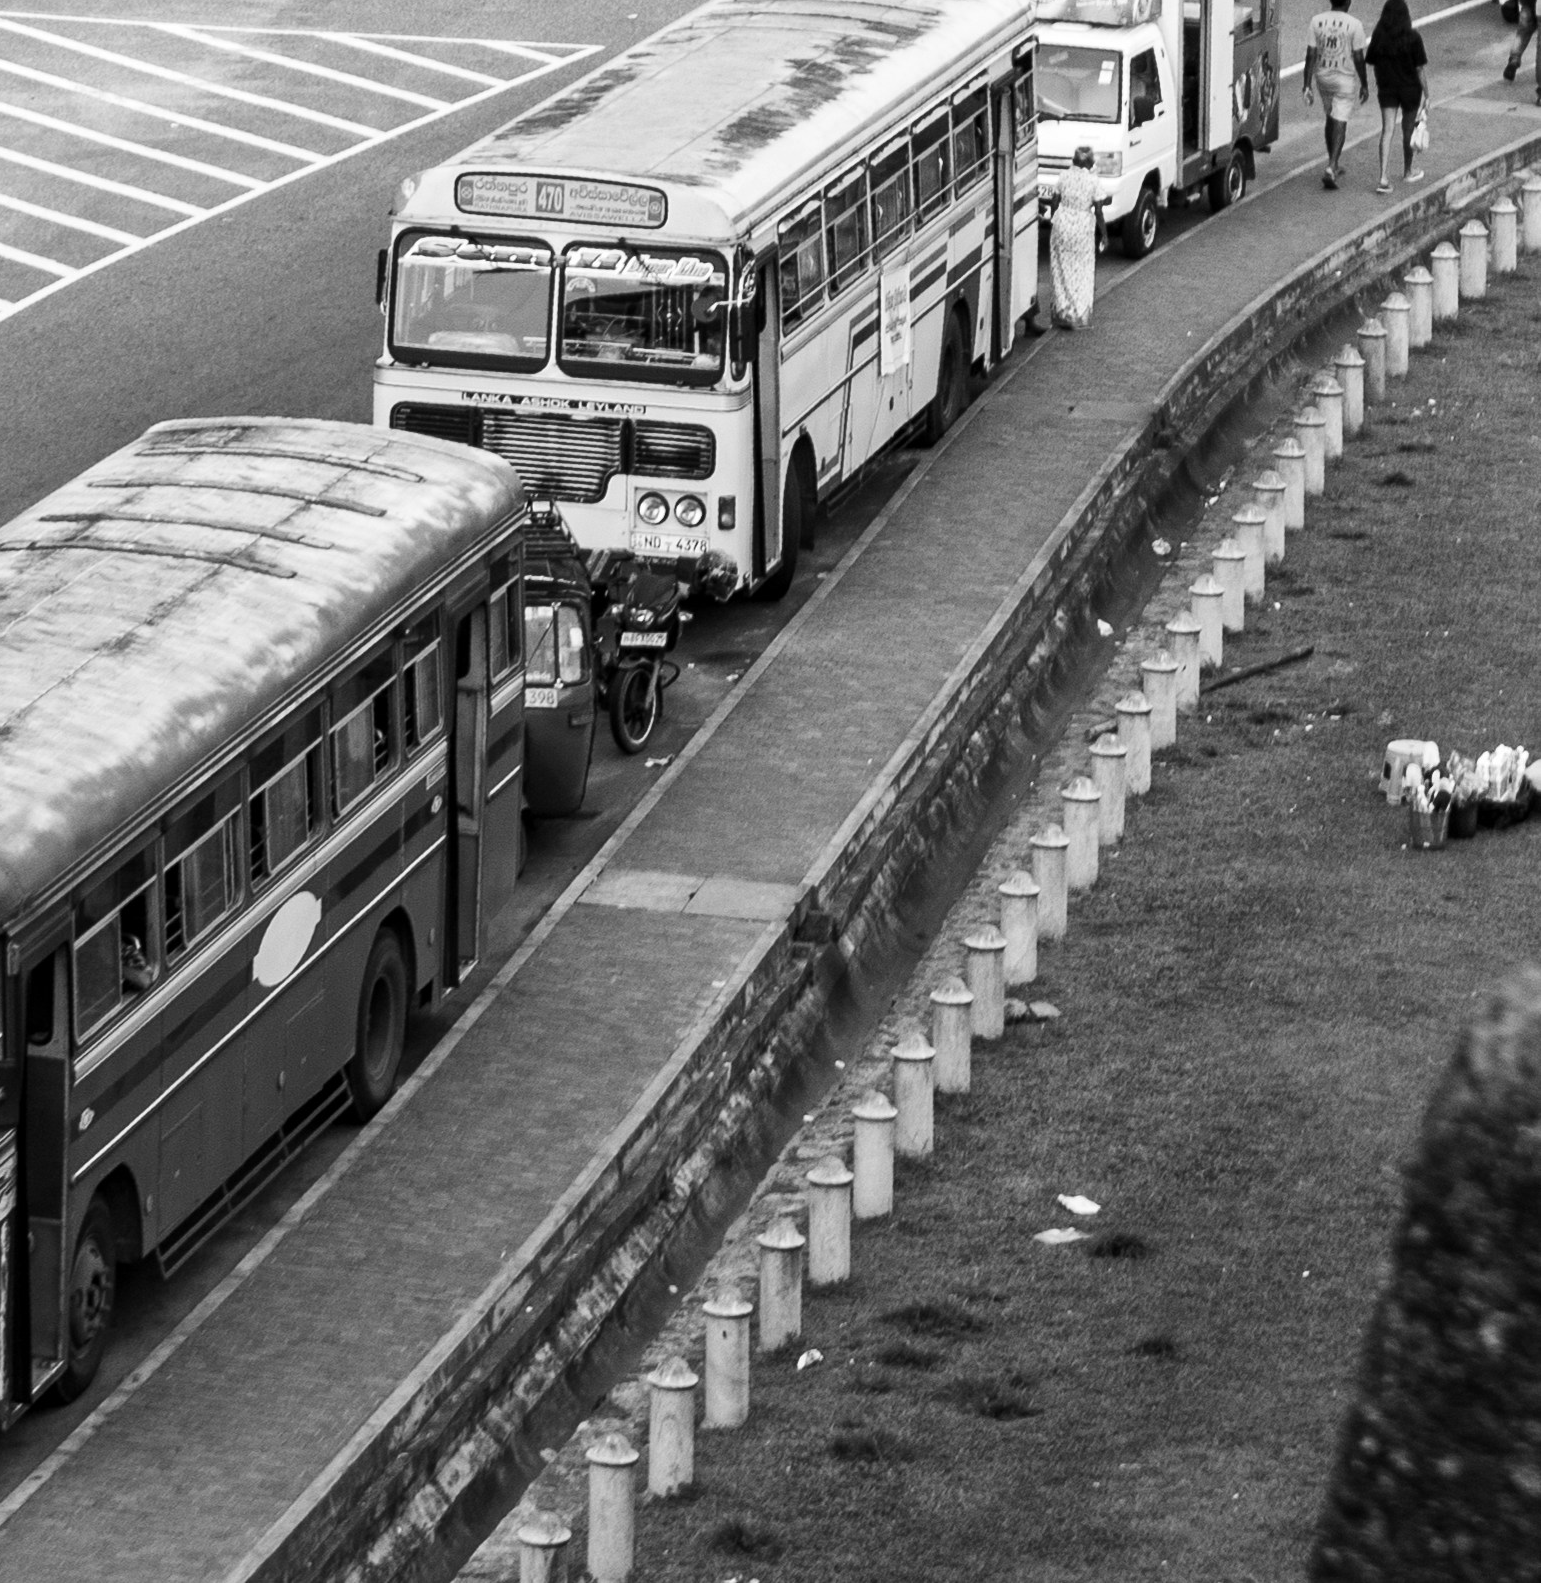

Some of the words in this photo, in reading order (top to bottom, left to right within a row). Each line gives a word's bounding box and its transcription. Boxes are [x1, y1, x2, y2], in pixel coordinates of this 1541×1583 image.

[538, 184, 562, 213] 470
[569, 210, 646, 224] AVISSAWELLA
[462, 391, 512, 405] LANKA
[520, 396, 570, 409] ASHOK
[578, 401, 645, 415] LEYLAND
[644, 534, 662, 548] ND
[676, 536, 708, 553] 4378
[529, 689, 555, 705] 398
